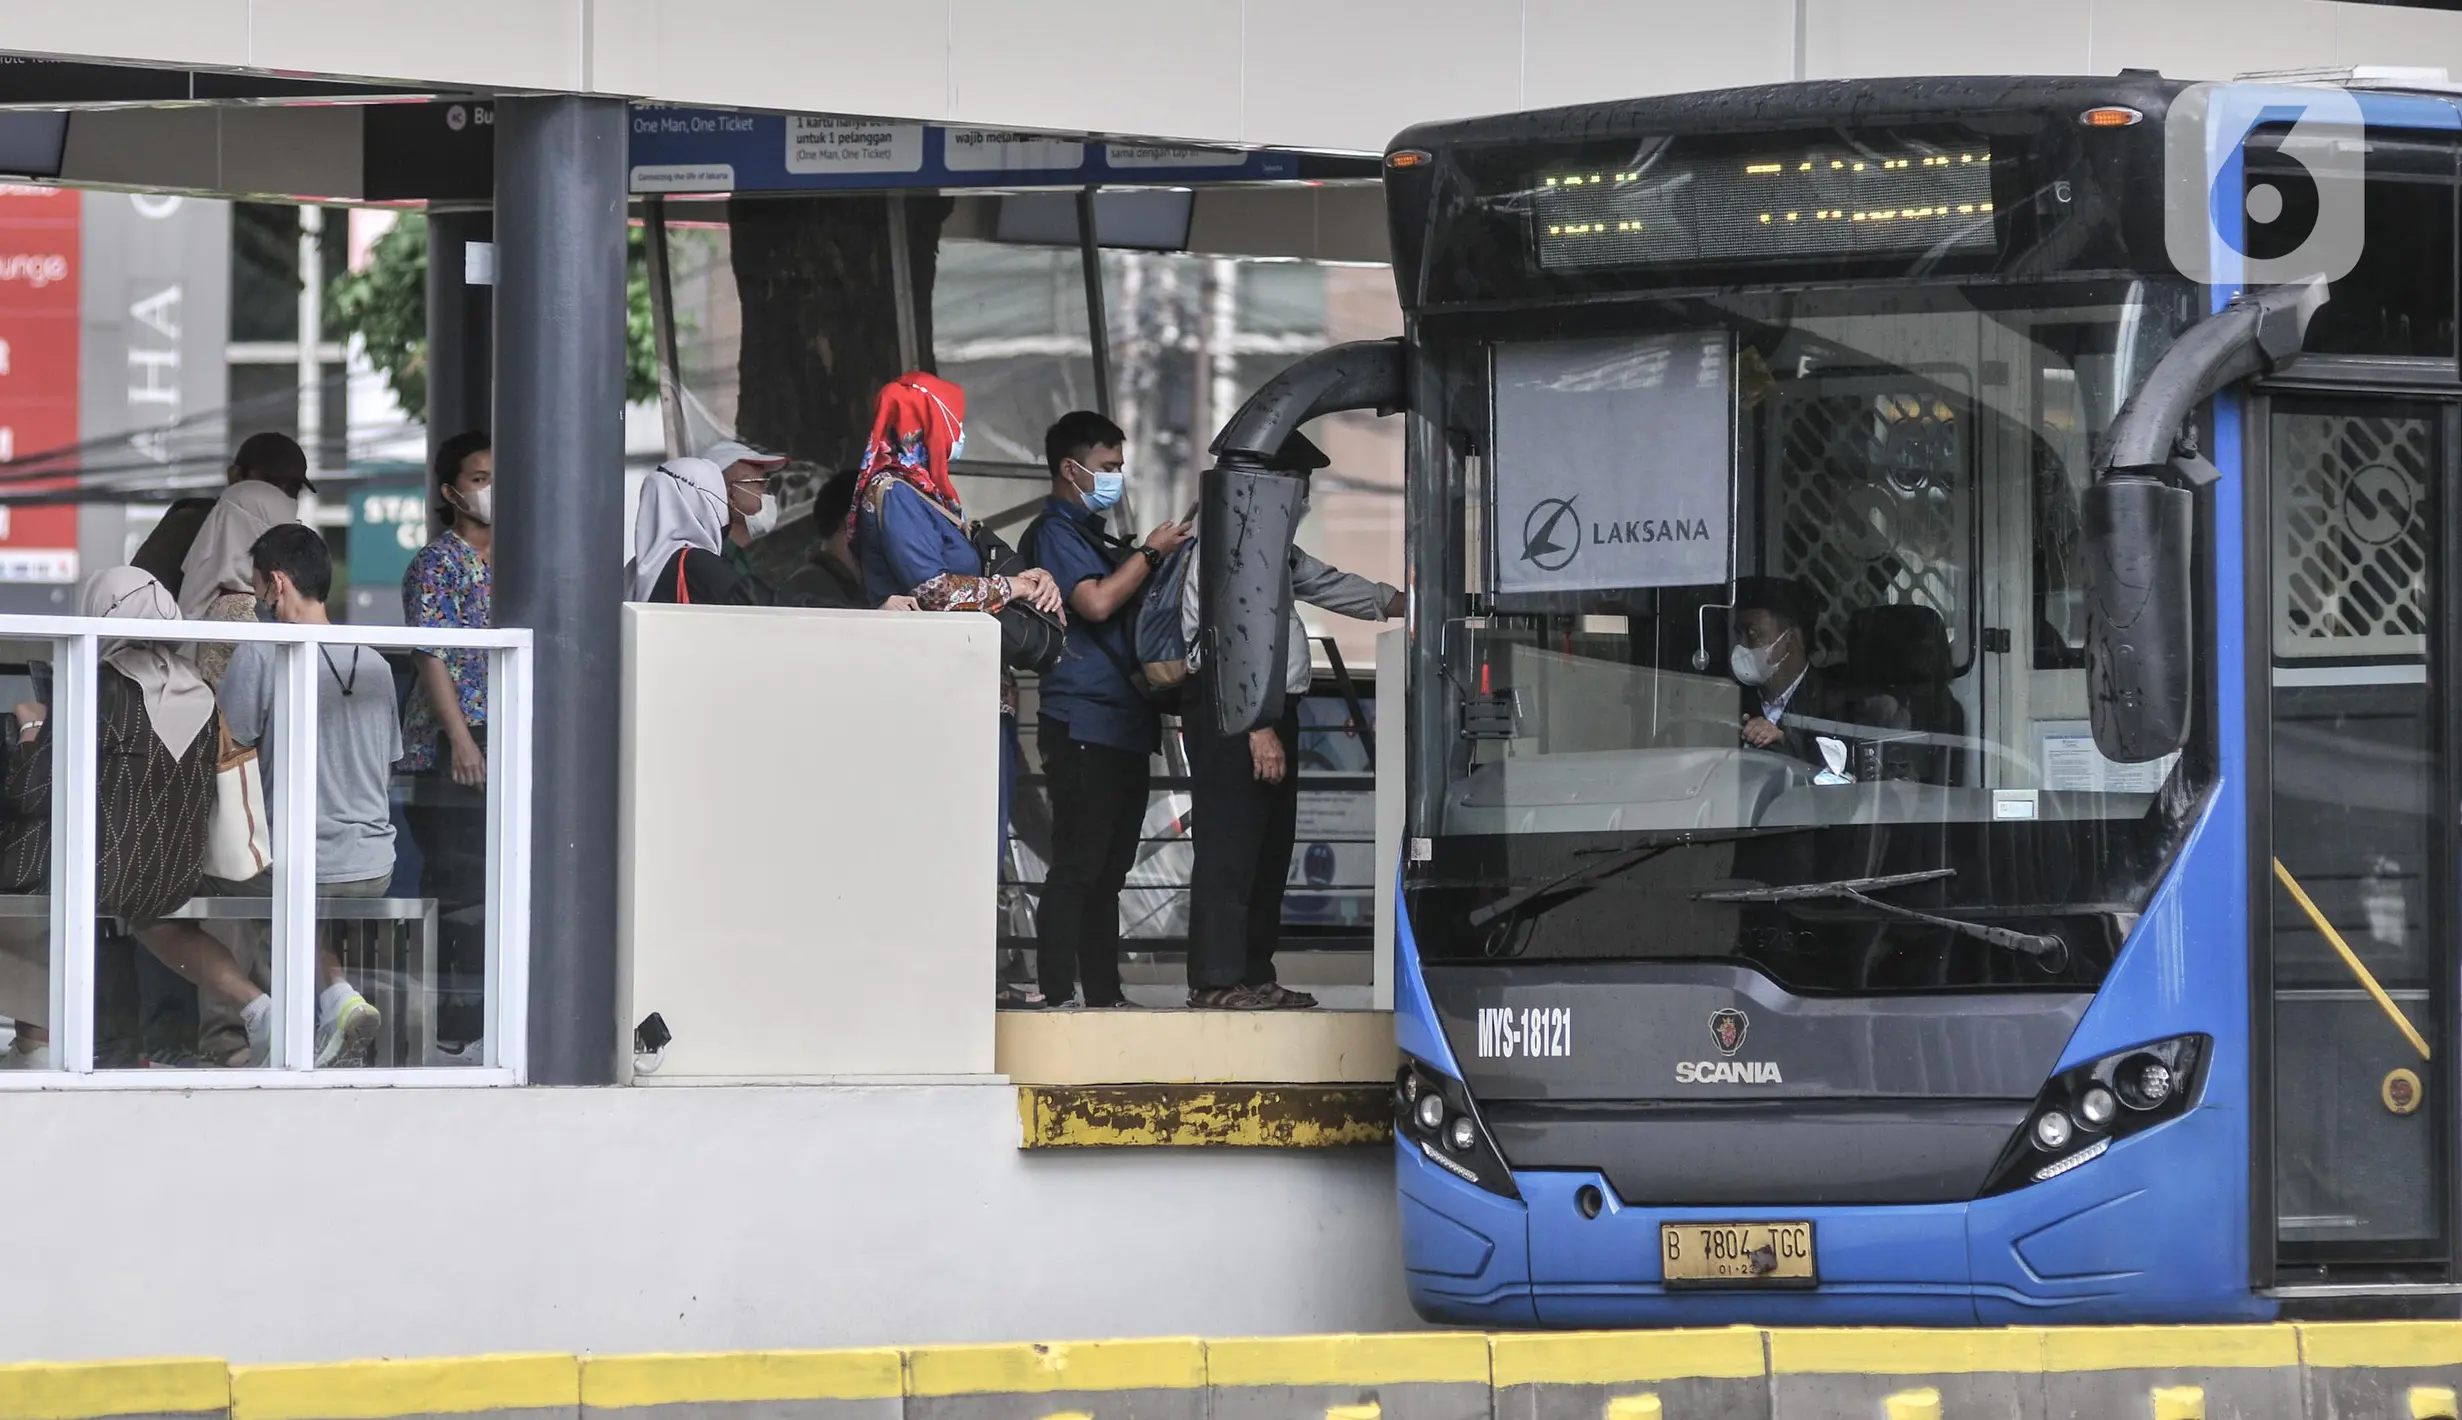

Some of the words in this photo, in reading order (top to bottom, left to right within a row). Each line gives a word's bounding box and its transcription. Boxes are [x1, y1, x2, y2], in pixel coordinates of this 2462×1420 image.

[634, 118, 657, 133] One
[660, 118, 689, 133] Man,
[691, 117, 715, 132] One
[718, 116, 753, 131] Ticket
[797, 132, 825, 144] untuk
[828, 132, 834, 143] 1
[838, 132, 892, 146] pelanggan
[955, 132, 983, 146] wajib
[796, 149, 816, 162] (One
[842, 148, 859, 160] One
[1111, 150, 1134, 158] sama
[364, 495, 425, 524] STA
[1593, 519, 1709, 544] LAKSANA
[1478, 1007, 1571, 1058] MYS-18121
[1676, 1061, 1783, 1084] SCANIA
[1668, 1231, 1681, 1260] B
[1701, 1230, 1751, 1260] 7804
[1768, 1228, 1806, 1258] TGC
